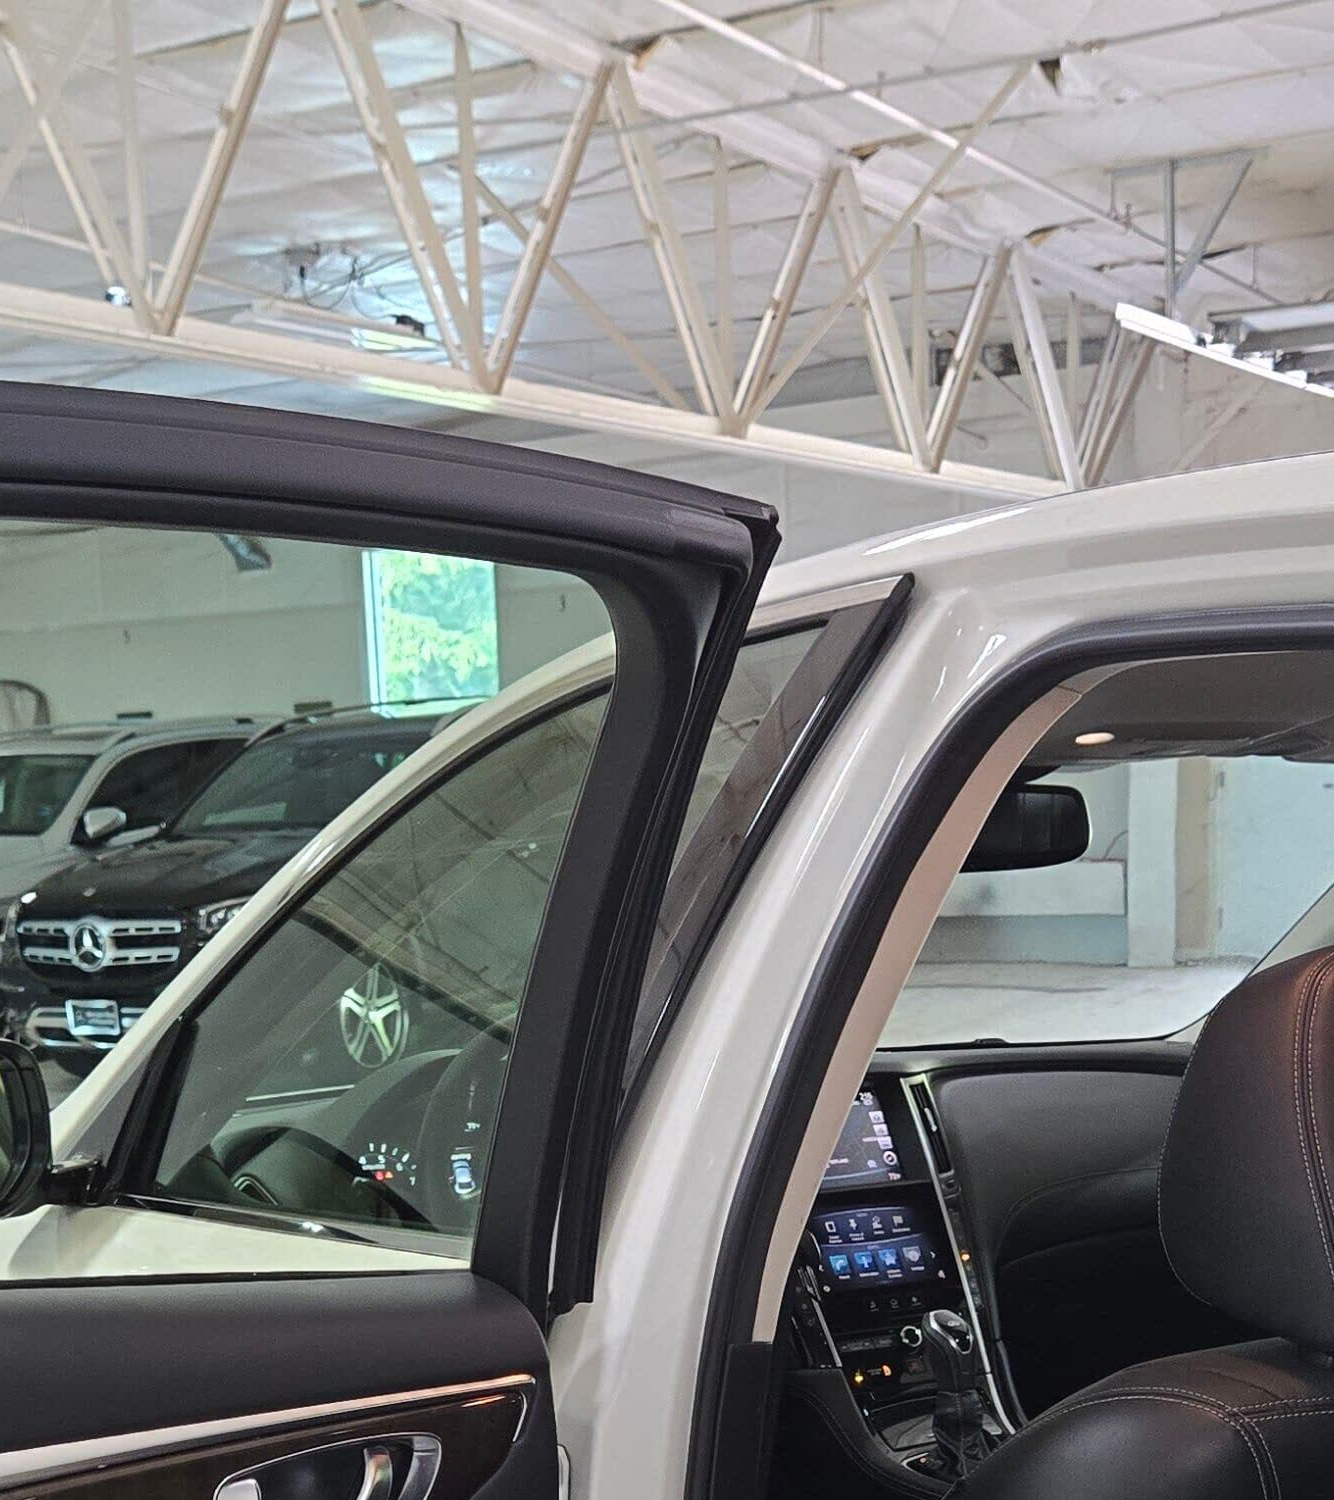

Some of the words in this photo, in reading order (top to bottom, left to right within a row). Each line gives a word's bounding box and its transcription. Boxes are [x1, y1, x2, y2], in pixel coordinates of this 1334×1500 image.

[377, 1155, 386, 1164] 5
[395, 1162, 403, 1171] 6
[409, 1176, 416, 1186] 7
